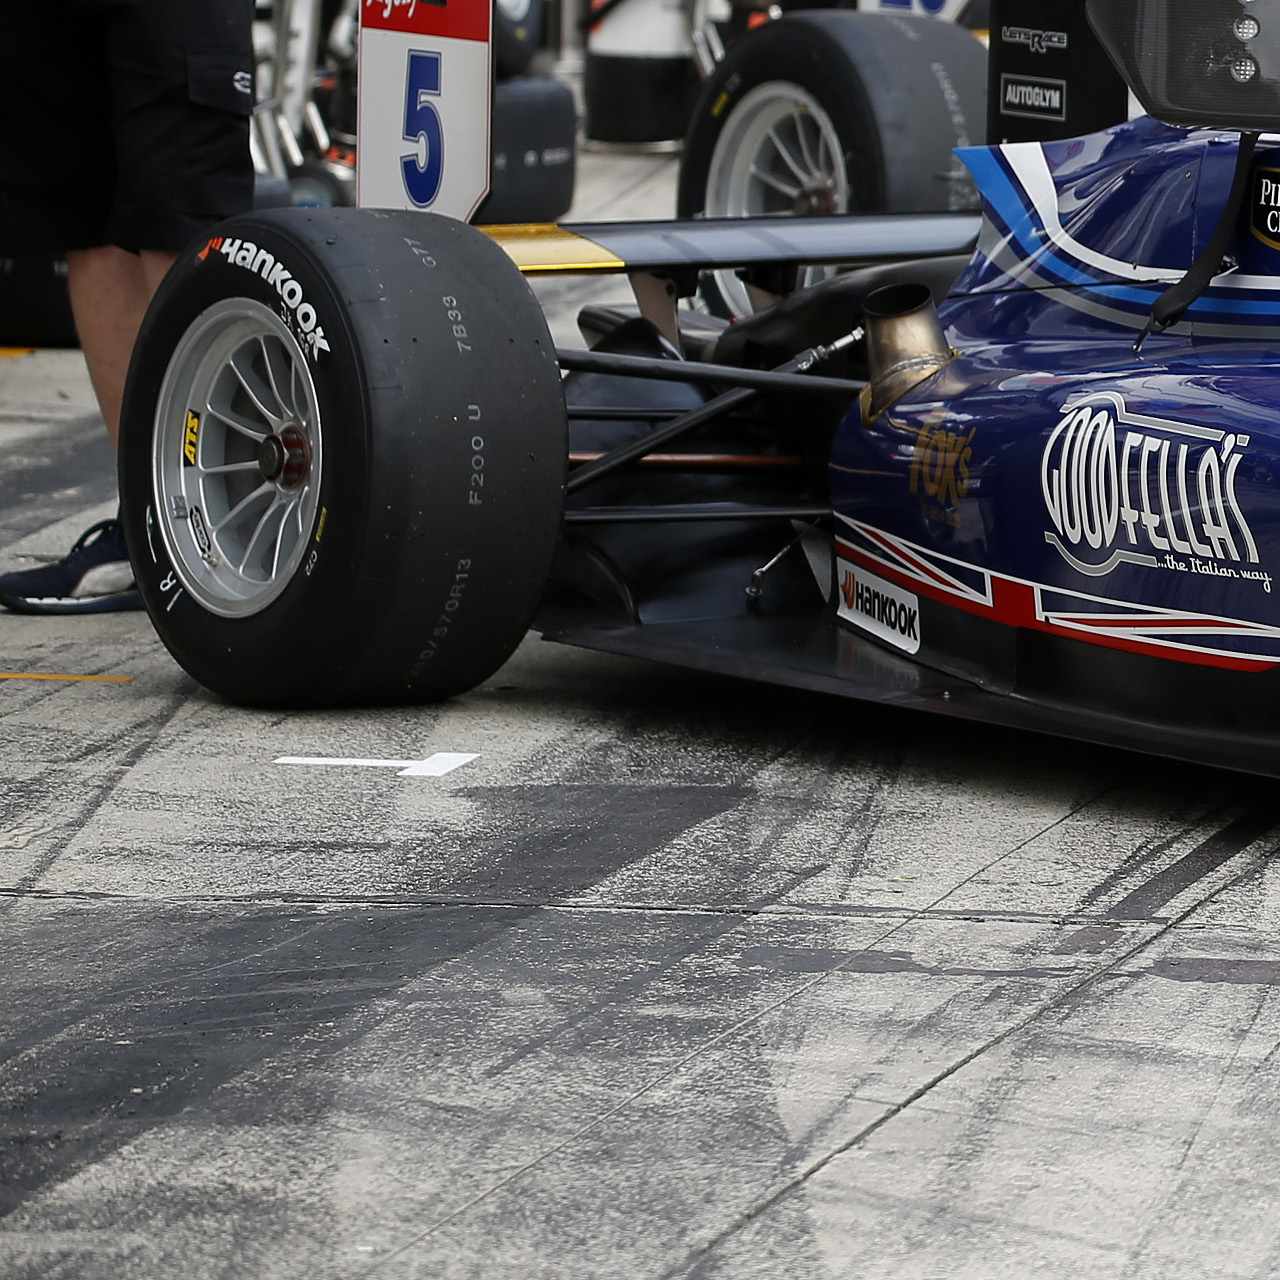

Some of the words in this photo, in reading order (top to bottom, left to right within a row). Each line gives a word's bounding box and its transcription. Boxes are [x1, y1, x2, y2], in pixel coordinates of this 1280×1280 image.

[1005, 83, 1061, 109] AUTOGLYM
[400, 49, 442, 208] 5
[183, 409, 201, 467] ATS
[469, 434, 485, 506] F200
[1190, 556, 1240, 578] Italian
[1241, 569, 1273, 593] way
